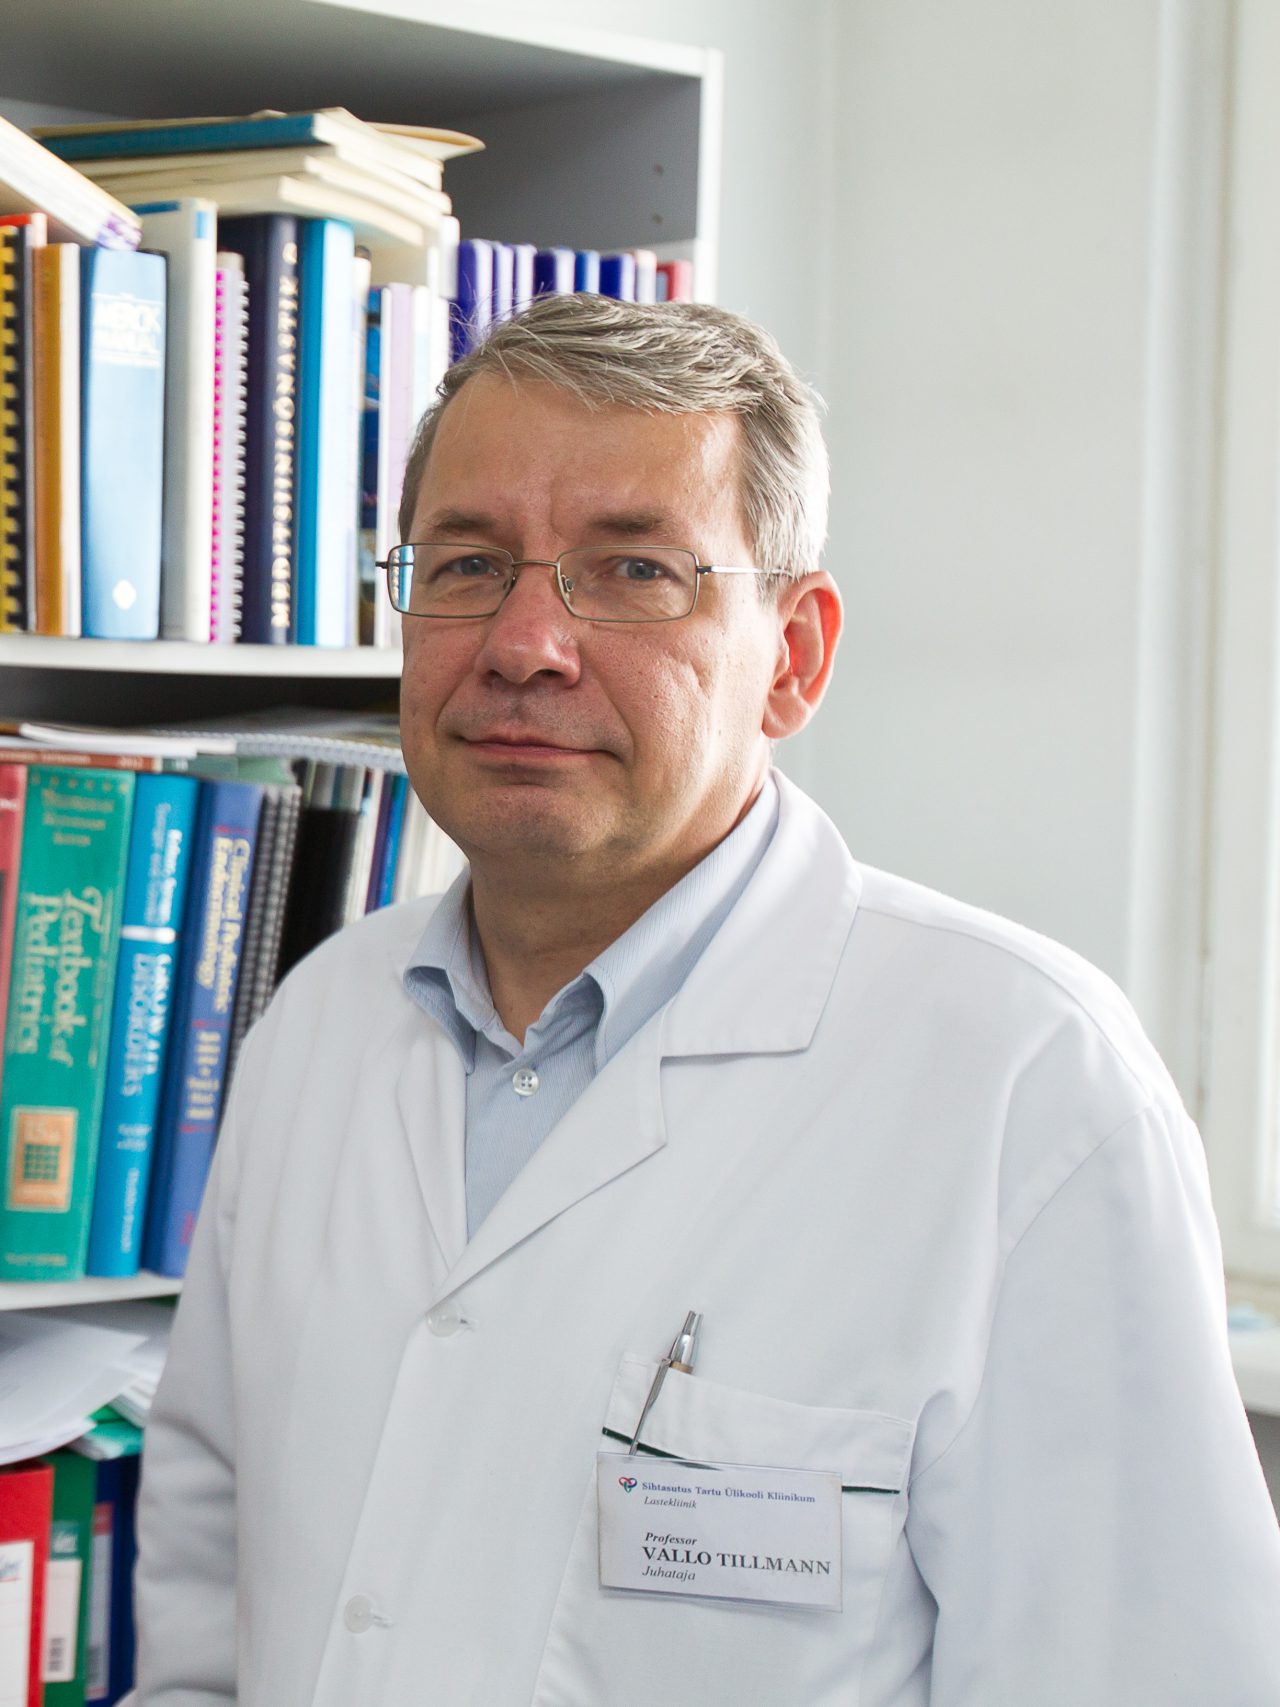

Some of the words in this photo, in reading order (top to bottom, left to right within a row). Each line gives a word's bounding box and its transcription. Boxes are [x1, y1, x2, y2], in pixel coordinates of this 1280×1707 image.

[225, 837, 251, 920] Clinical
[642, 1481, 692, 1495] Sihtasutus
[696, 1486, 722, 1497] Tartu
[724, 1486, 764, 1500] Ülikooli
[767, 1491, 816, 1503] Kliinikum
[643, 1496, 697, 1509] Lastekliinik
[645, 1532, 698, 1547] Professor
[642, 1546, 712, 1566] VALLO
[716, 1552, 832, 1576] TILLMANN
[641, 1565, 697, 1581] Juhataja
